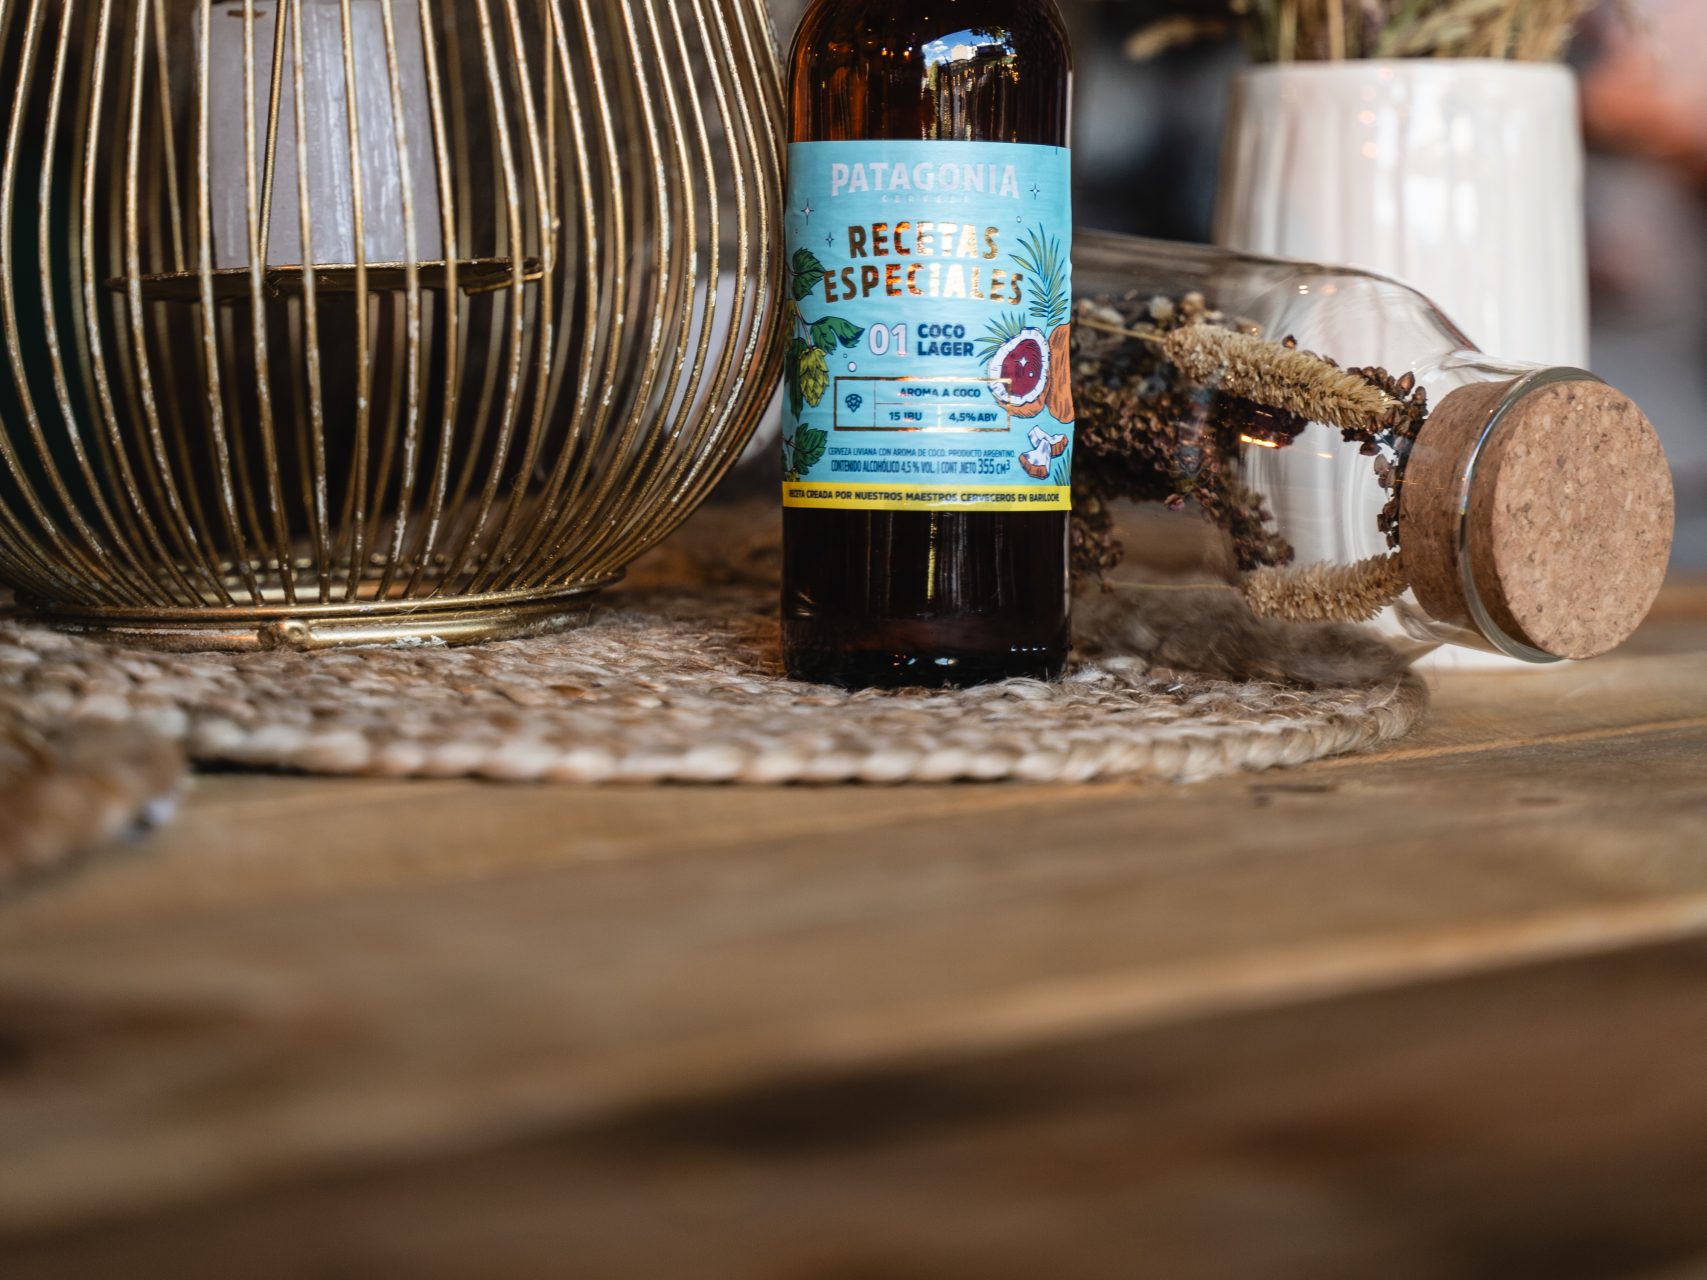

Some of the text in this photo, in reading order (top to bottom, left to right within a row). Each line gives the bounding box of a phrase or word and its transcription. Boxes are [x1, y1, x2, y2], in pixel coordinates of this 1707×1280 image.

[831, 162, 1020, 199] PATAGONIA
[848, 221, 999, 259] RECETAS
[823, 262, 1024, 305] ESPECIALES
[868, 322, 965, 356] 01 COCO
[917, 341, 975, 357] LAGER
[900, 387, 981, 398] AROMA A COCO
[889, 411, 923, 421] 15 IBU
[978, 412, 998, 422] ABV
[828, 447, 852, 456] CERVEZA
[893, 448, 916, 457] AROMA
[918, 448, 927, 457] DE
[948, 449, 981, 458] PRODUCTO
[978, 458, 995, 474] 355
[835, 491, 852, 500] POR
[855, 492, 903, 501] NUESTROS
[905, 493, 958, 502] MAESTROS
[960, 493, 1016, 503] CERVECEROS
[1018, 493, 1027, 503] EN
